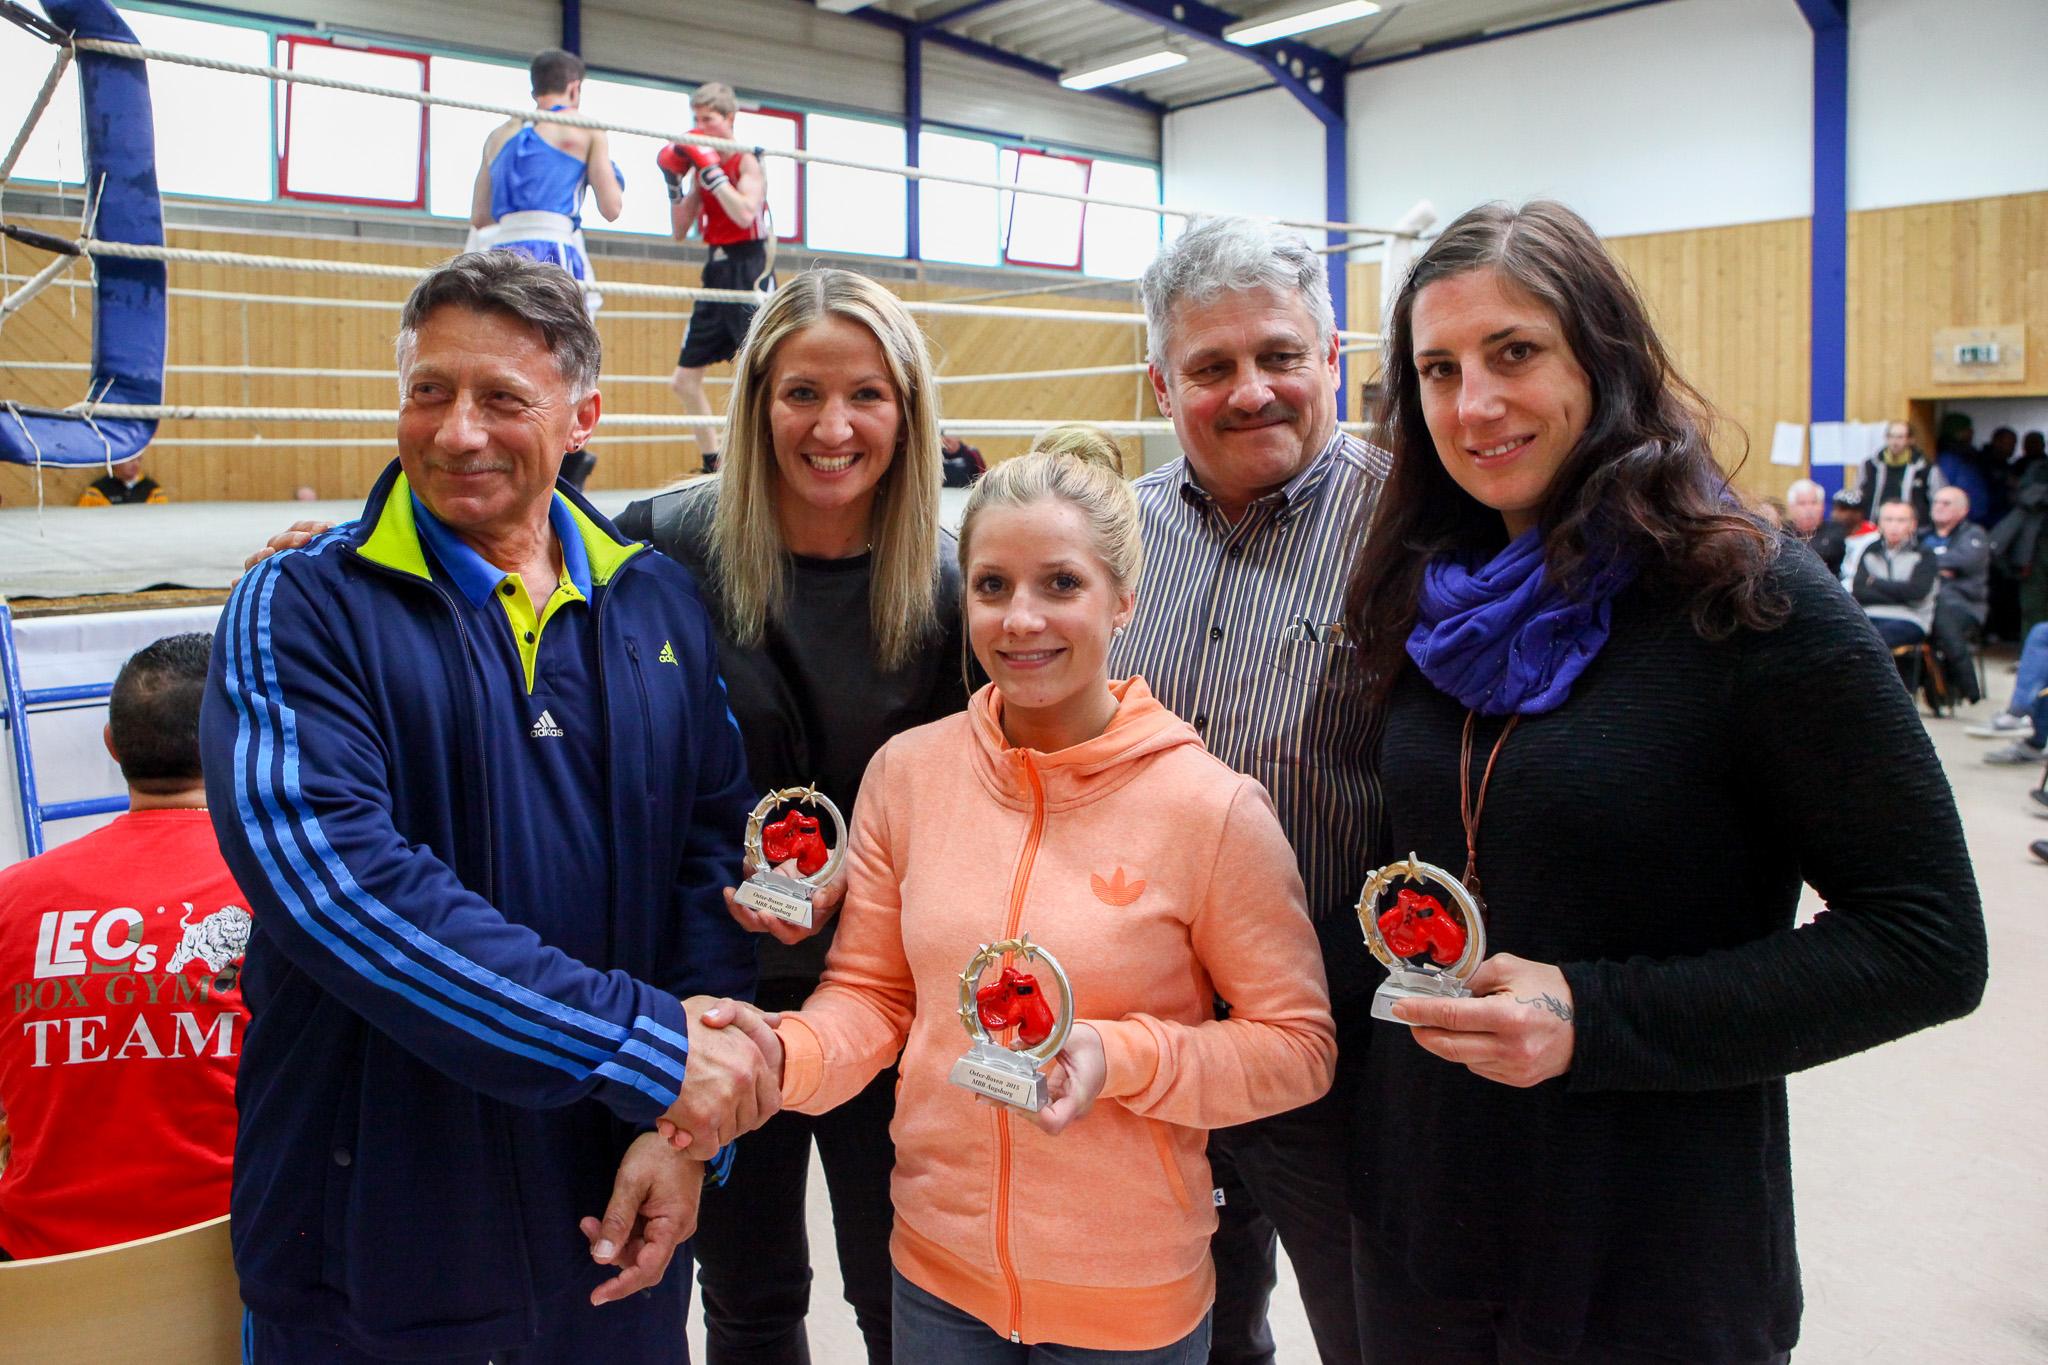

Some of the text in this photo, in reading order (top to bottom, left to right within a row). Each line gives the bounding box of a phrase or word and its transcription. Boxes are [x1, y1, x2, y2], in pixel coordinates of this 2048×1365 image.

[768, 904, 792, 917] Augsburg
[14, 973, 214, 1014] BOX GYM
[24, 1012, 241, 1068] TEAM
[987, 1084, 1014, 1098] Augsburg
[1005, 1082, 1020, 1091] 2015
